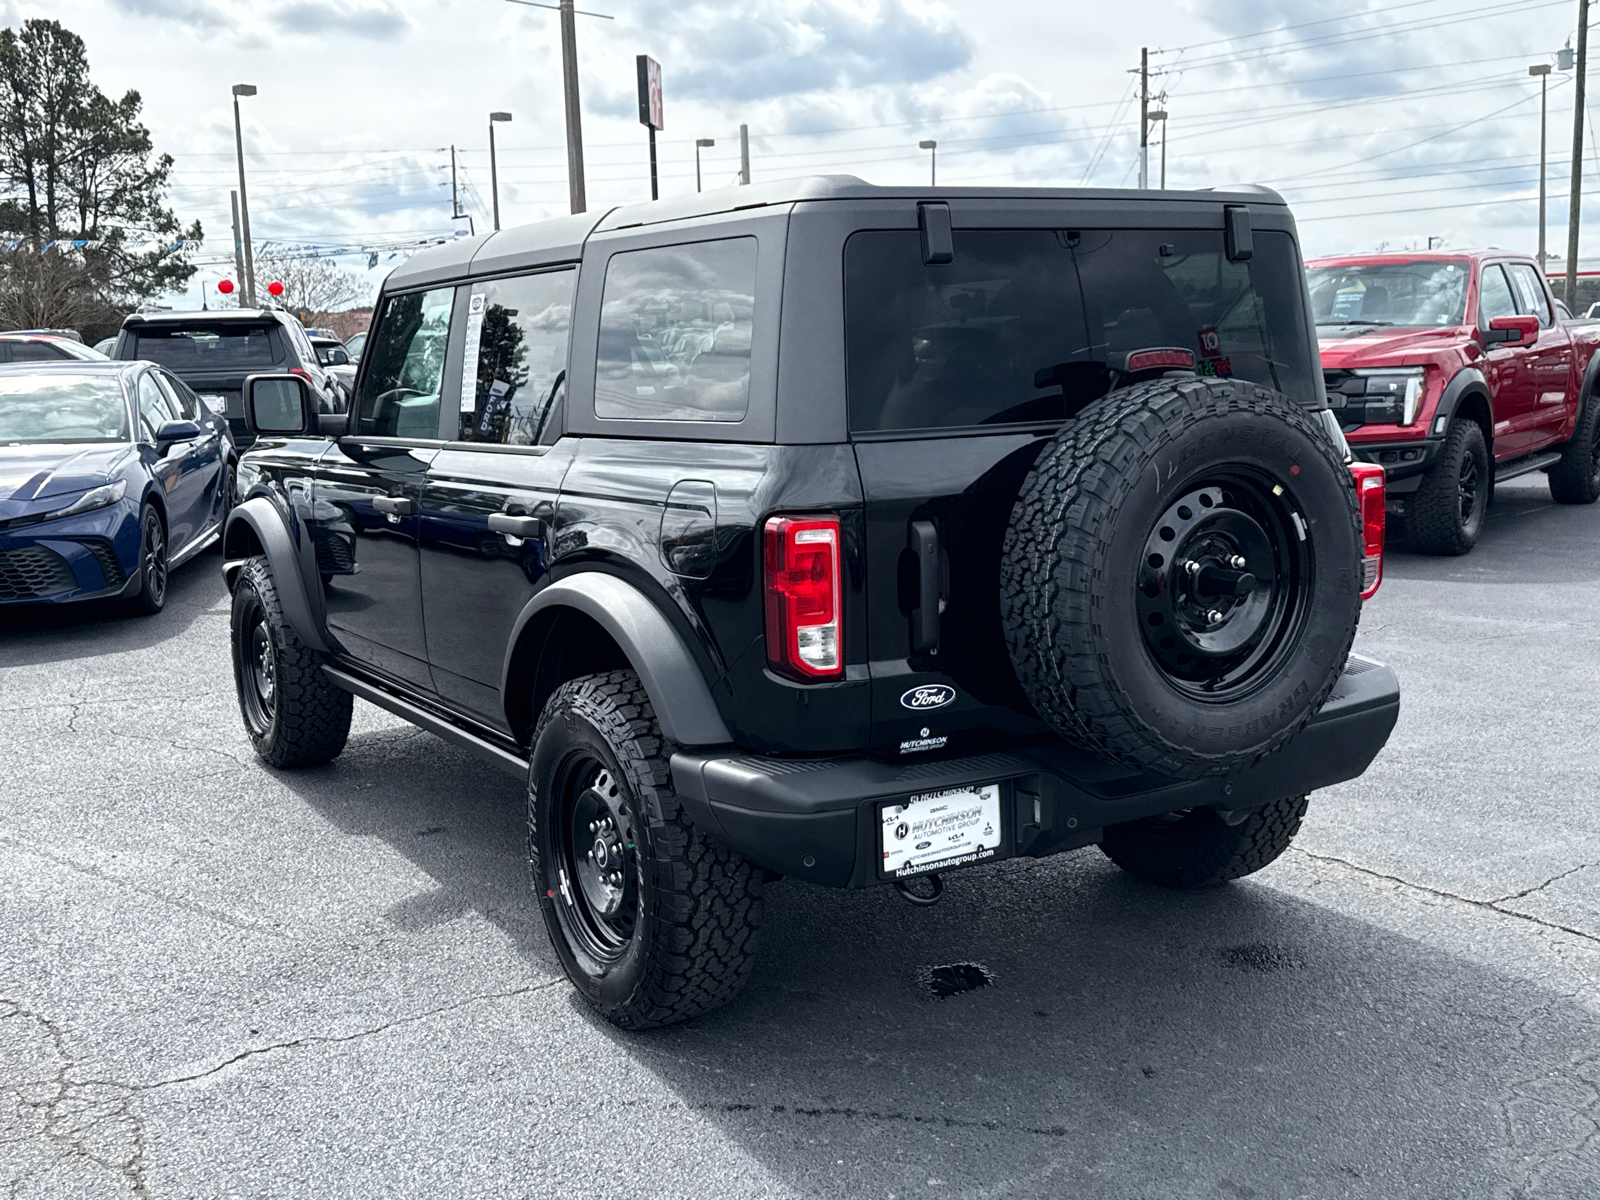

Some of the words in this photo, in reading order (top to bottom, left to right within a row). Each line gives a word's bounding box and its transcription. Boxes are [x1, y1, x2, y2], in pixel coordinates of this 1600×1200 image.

[480, 396, 496, 430] FORD
[1179, 424, 1304, 466] GENERAL
[911, 688, 946, 706] Ford
[1187, 679, 1310, 744] GRABBER
[900, 736, 948, 750] HUTCHINSON
[911, 806, 983, 834] HUTCHINSON
[930, 805, 948, 813] GMC
[913, 824, 956, 841] AUTOMOTIVE
[957, 817, 980, 830] GROUP
[896, 849, 995, 877] Hutchinsonautogroup.com
